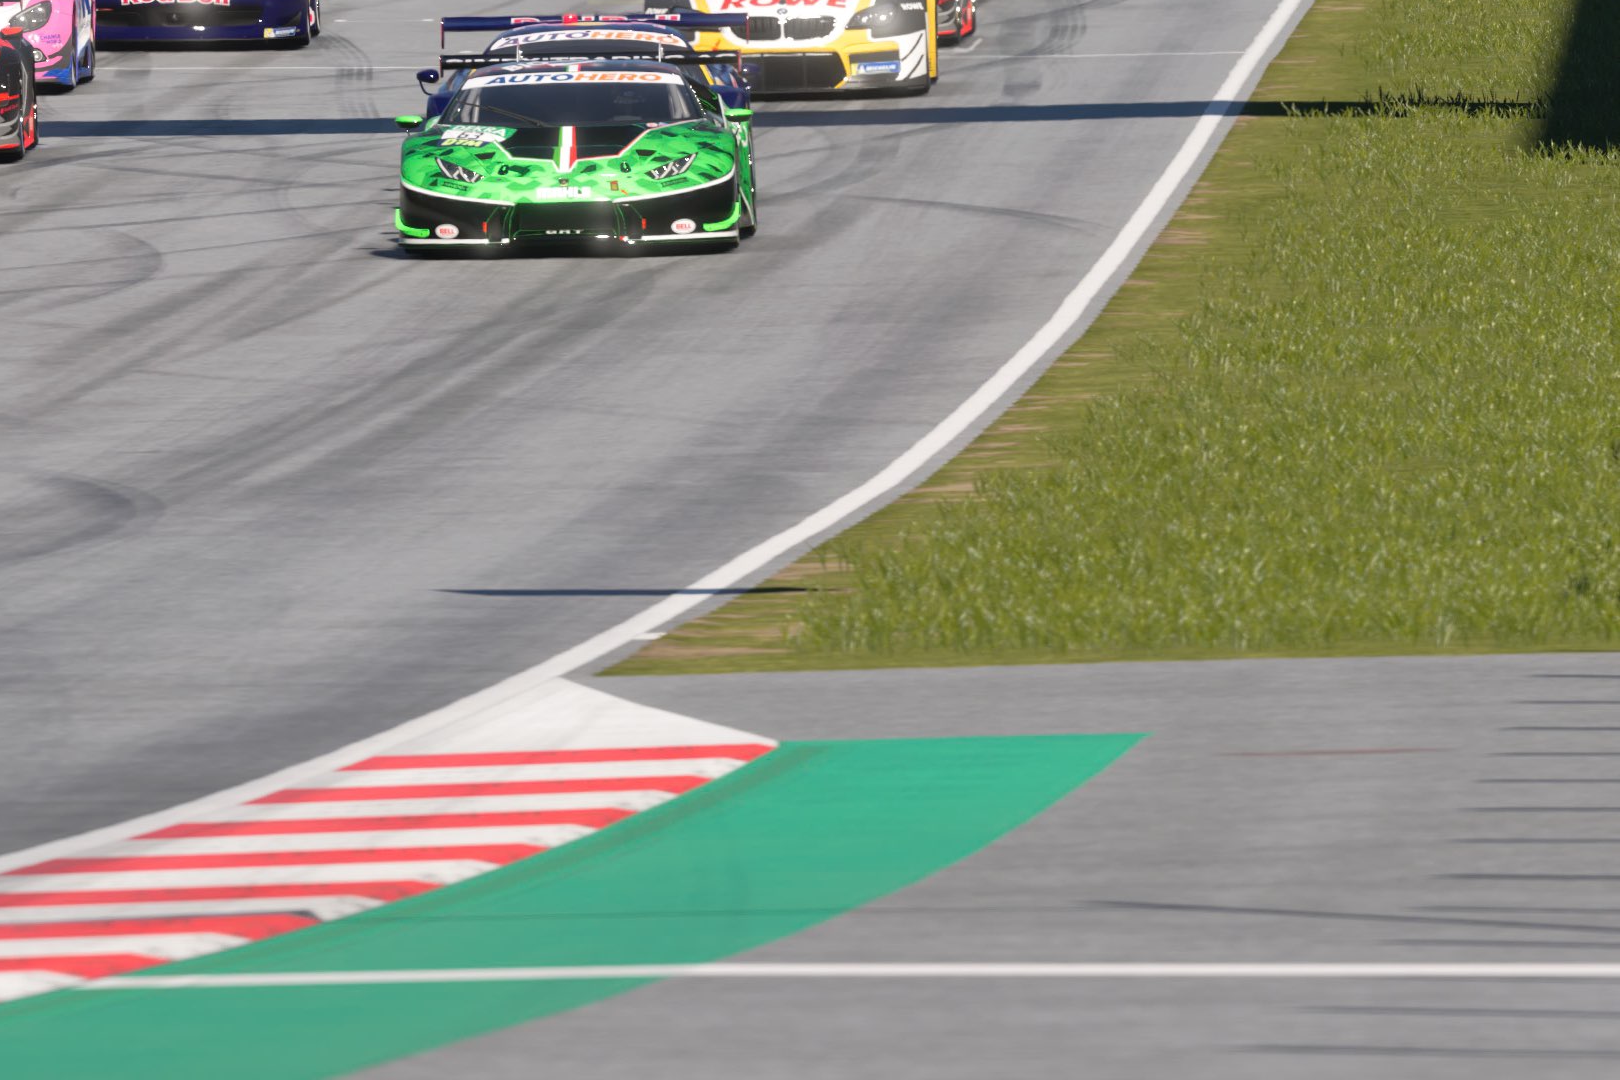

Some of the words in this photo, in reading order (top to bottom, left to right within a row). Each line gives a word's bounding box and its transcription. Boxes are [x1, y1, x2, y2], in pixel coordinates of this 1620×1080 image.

[502, 30, 680, 46] AUTOHERO
[485, 71, 662, 86] AUTOHERO
[452, 126, 507, 138] DEKRA
[441, 139, 485, 147] DTM
[439, 227, 456, 236] BELL
[675, 222, 692, 231] BELL
